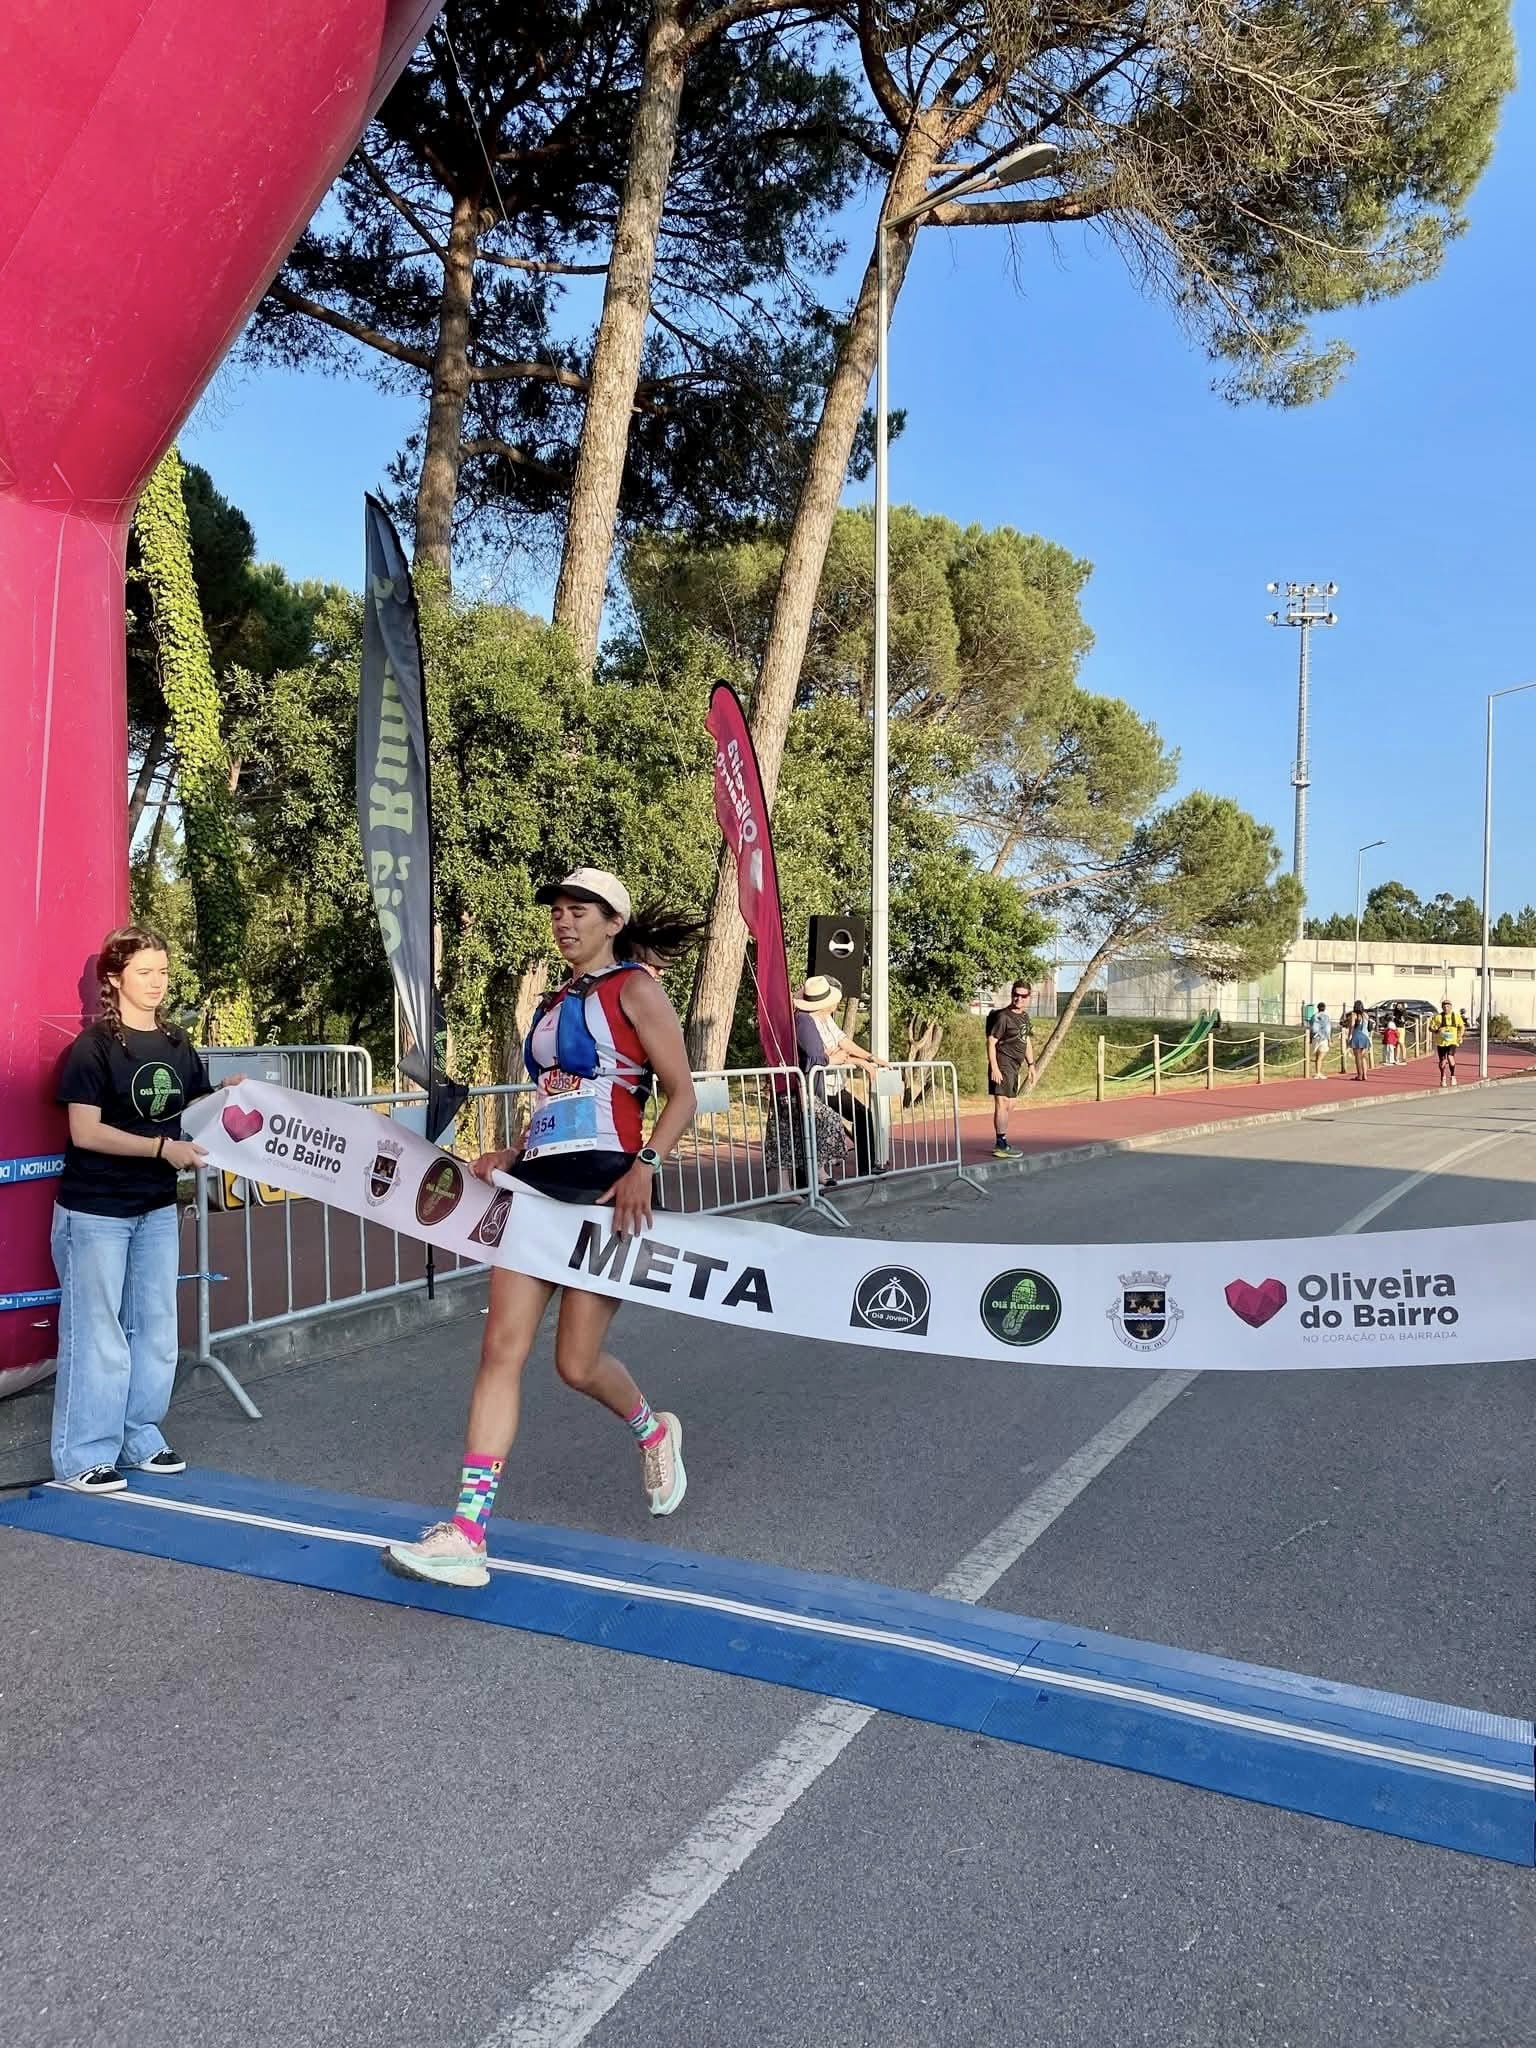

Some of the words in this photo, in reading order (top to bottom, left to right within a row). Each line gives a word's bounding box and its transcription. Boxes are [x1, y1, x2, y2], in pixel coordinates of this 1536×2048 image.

[269, 1114, 347, 1154] Oliveira
[264, 1137, 289, 1157] do
[292, 1143, 342, 1174] Bairro
[568, 1220, 774, 1314] META
[1298, 1268, 1456, 1302] Oliveira
[1010, 1301, 1050, 1311] Runners
[1300, 1304, 1343, 1329] do
[1353, 1302, 1459, 1328] Bairro
[1302, 1335, 1320, 1344] NO
[1379, 1333, 1395, 1342] DA
[1399, 1330, 1459, 1342] BAIRRADA
